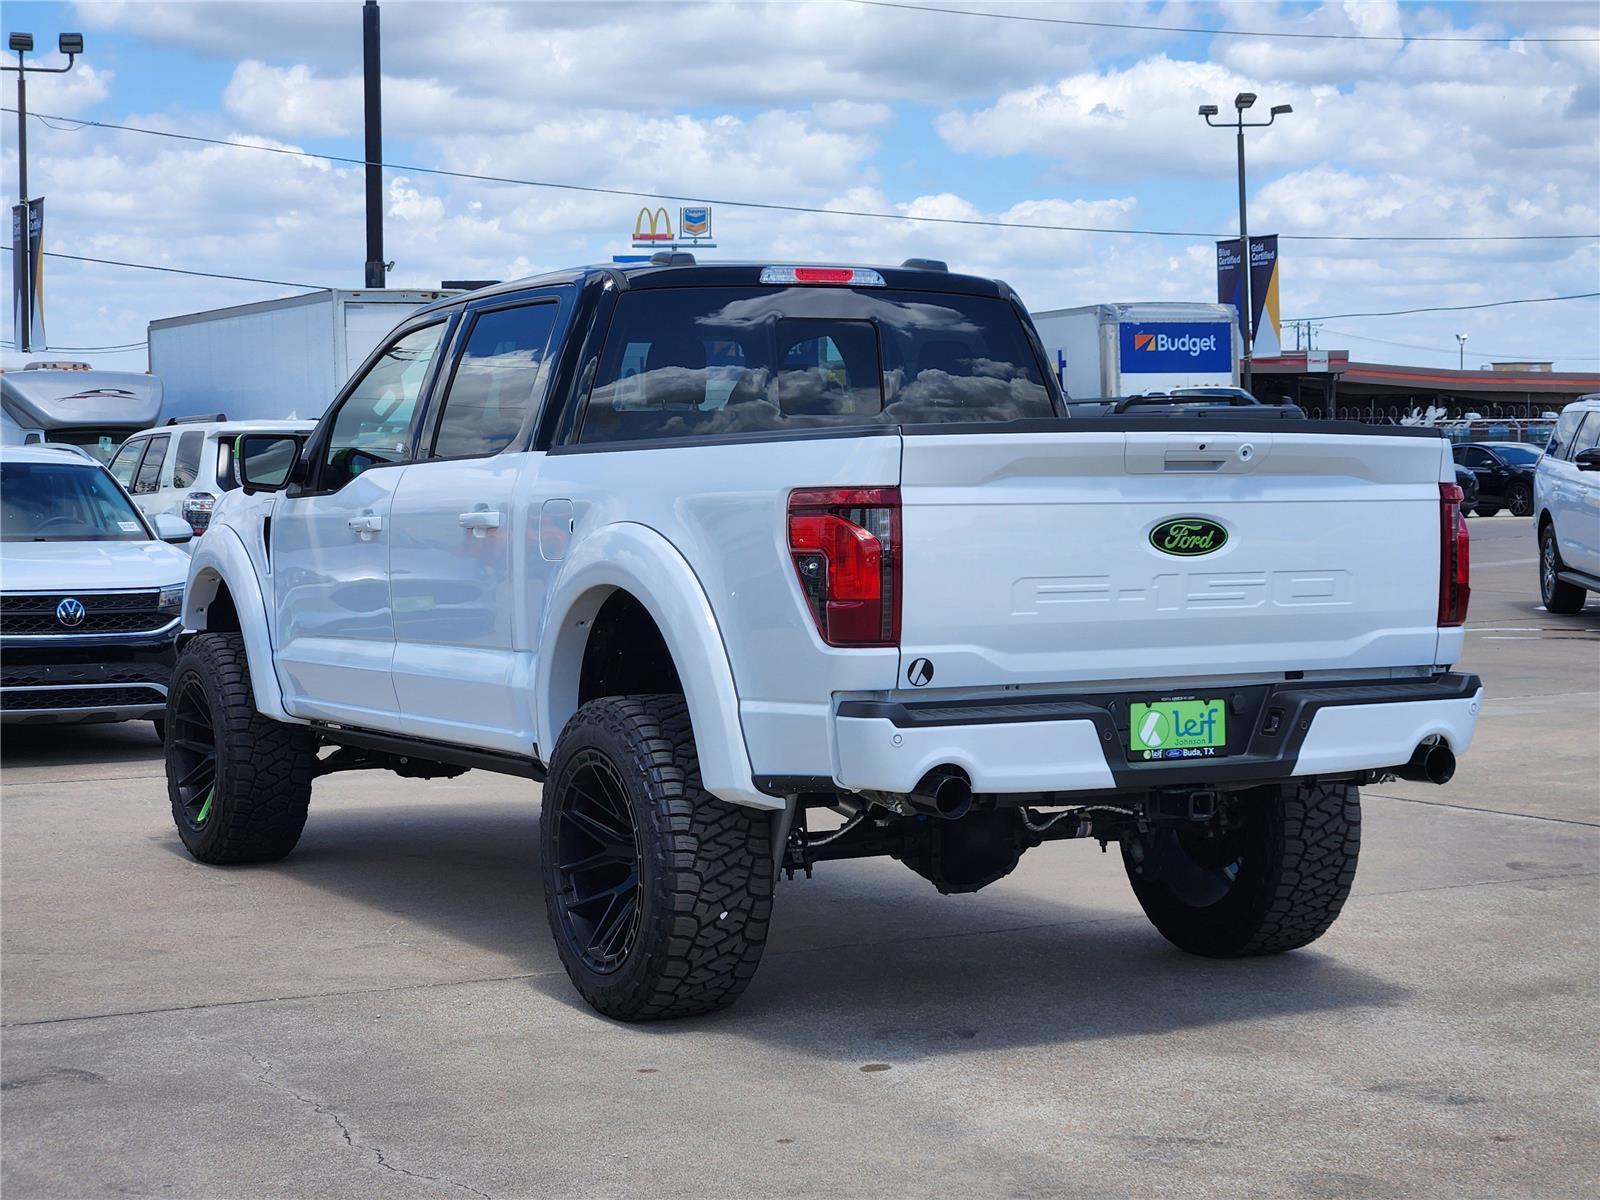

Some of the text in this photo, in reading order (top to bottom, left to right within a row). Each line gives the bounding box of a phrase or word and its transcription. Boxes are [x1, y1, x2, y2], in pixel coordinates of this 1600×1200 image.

[1157, 334, 1217, 356] Budget
[1164, 523, 1215, 549] Ford
[1011, 569, 1353, 616] F-150
[1175, 738, 1206, 746] Johnson
[1183, 748, 1202, 756] Buda,
[1203, 747, 1215, 755] TX
